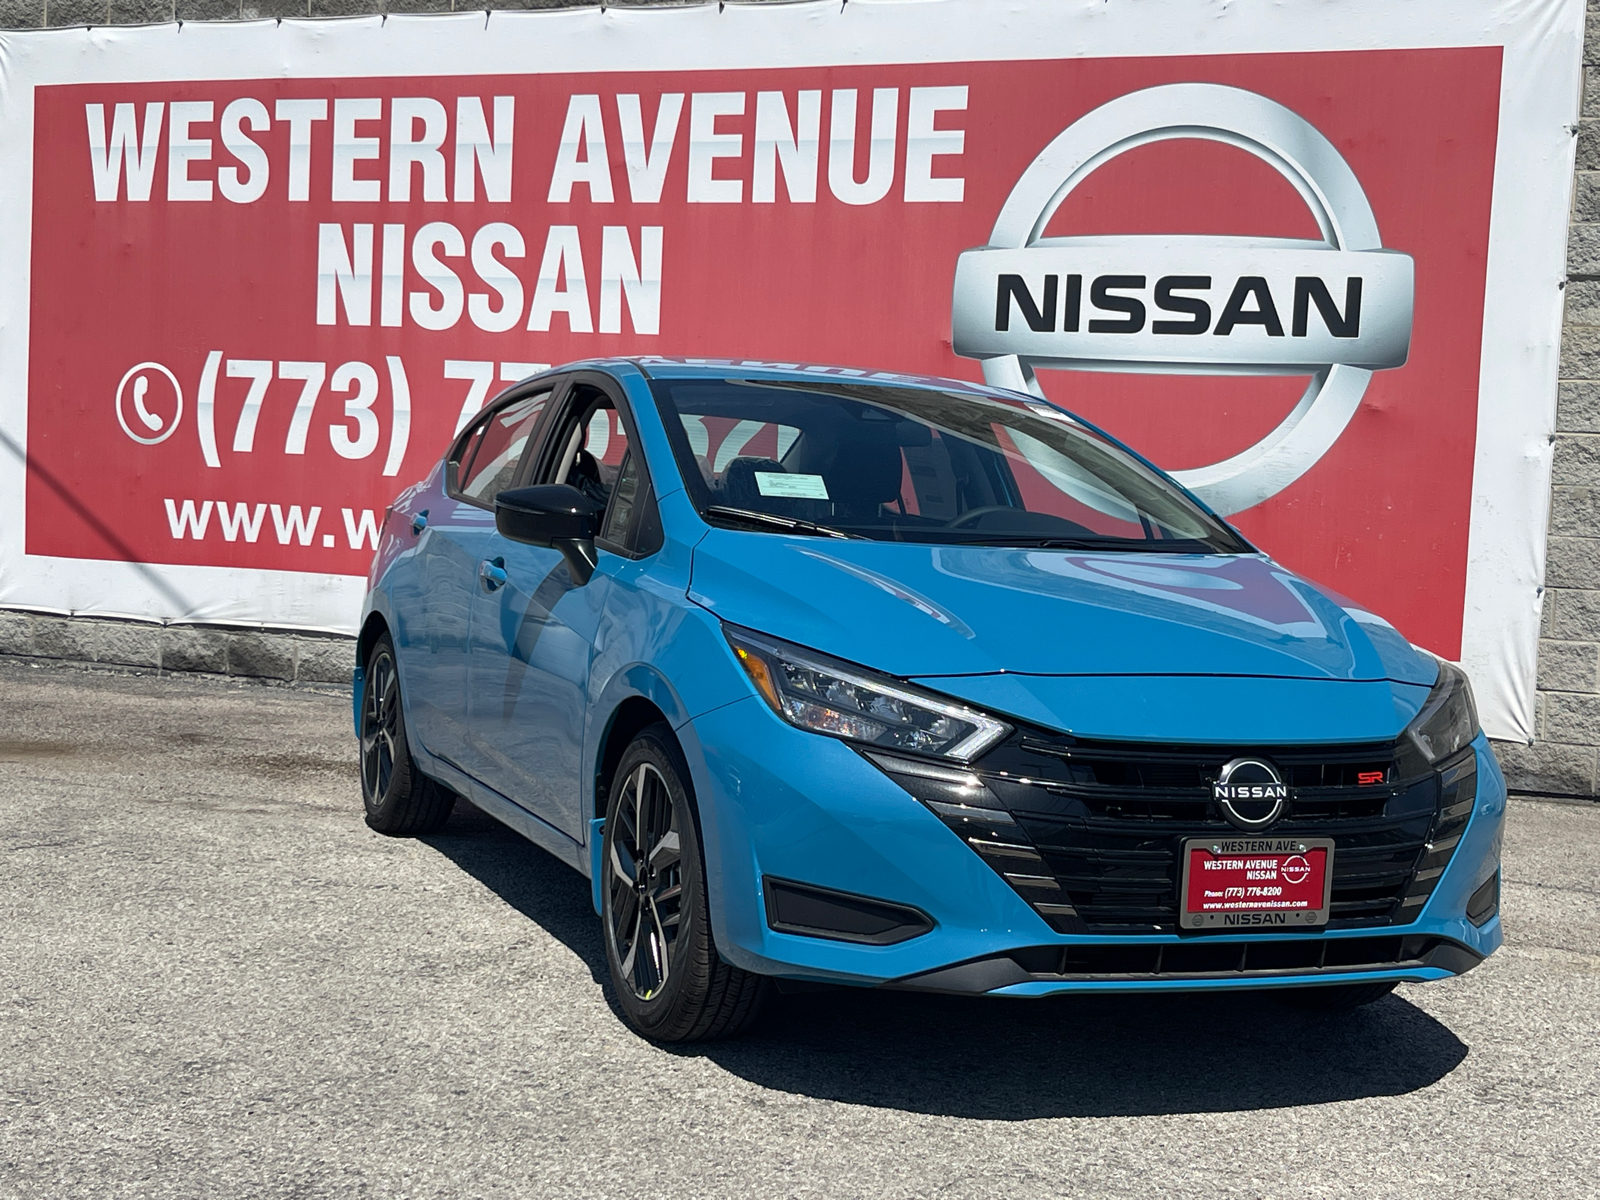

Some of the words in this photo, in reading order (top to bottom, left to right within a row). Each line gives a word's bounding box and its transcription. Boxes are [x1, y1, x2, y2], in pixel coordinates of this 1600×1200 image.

[86, 96, 515, 204] WESTERN
[547, 85, 969, 205] AVENUE
[316, 221, 664, 336] NISSAN
[995, 273, 1363, 338] NISSAN
[197, 350, 411, 477] (773)
[1358, 771, 1384, 784] SR
[1215, 786, 1287, 798] NISSAN
[1221, 841, 1273, 852] WESTERN
[1203, 860, 1244, 870] WESTERN
[1244, 860, 1278, 869] AVENUE
[1246, 870, 1277, 880] NISSAN
[1224, 887, 1245, 899] (773)
[1246, 886, 1282, 897] 776-8200
[1224, 913, 1286, 925] NISSAN
